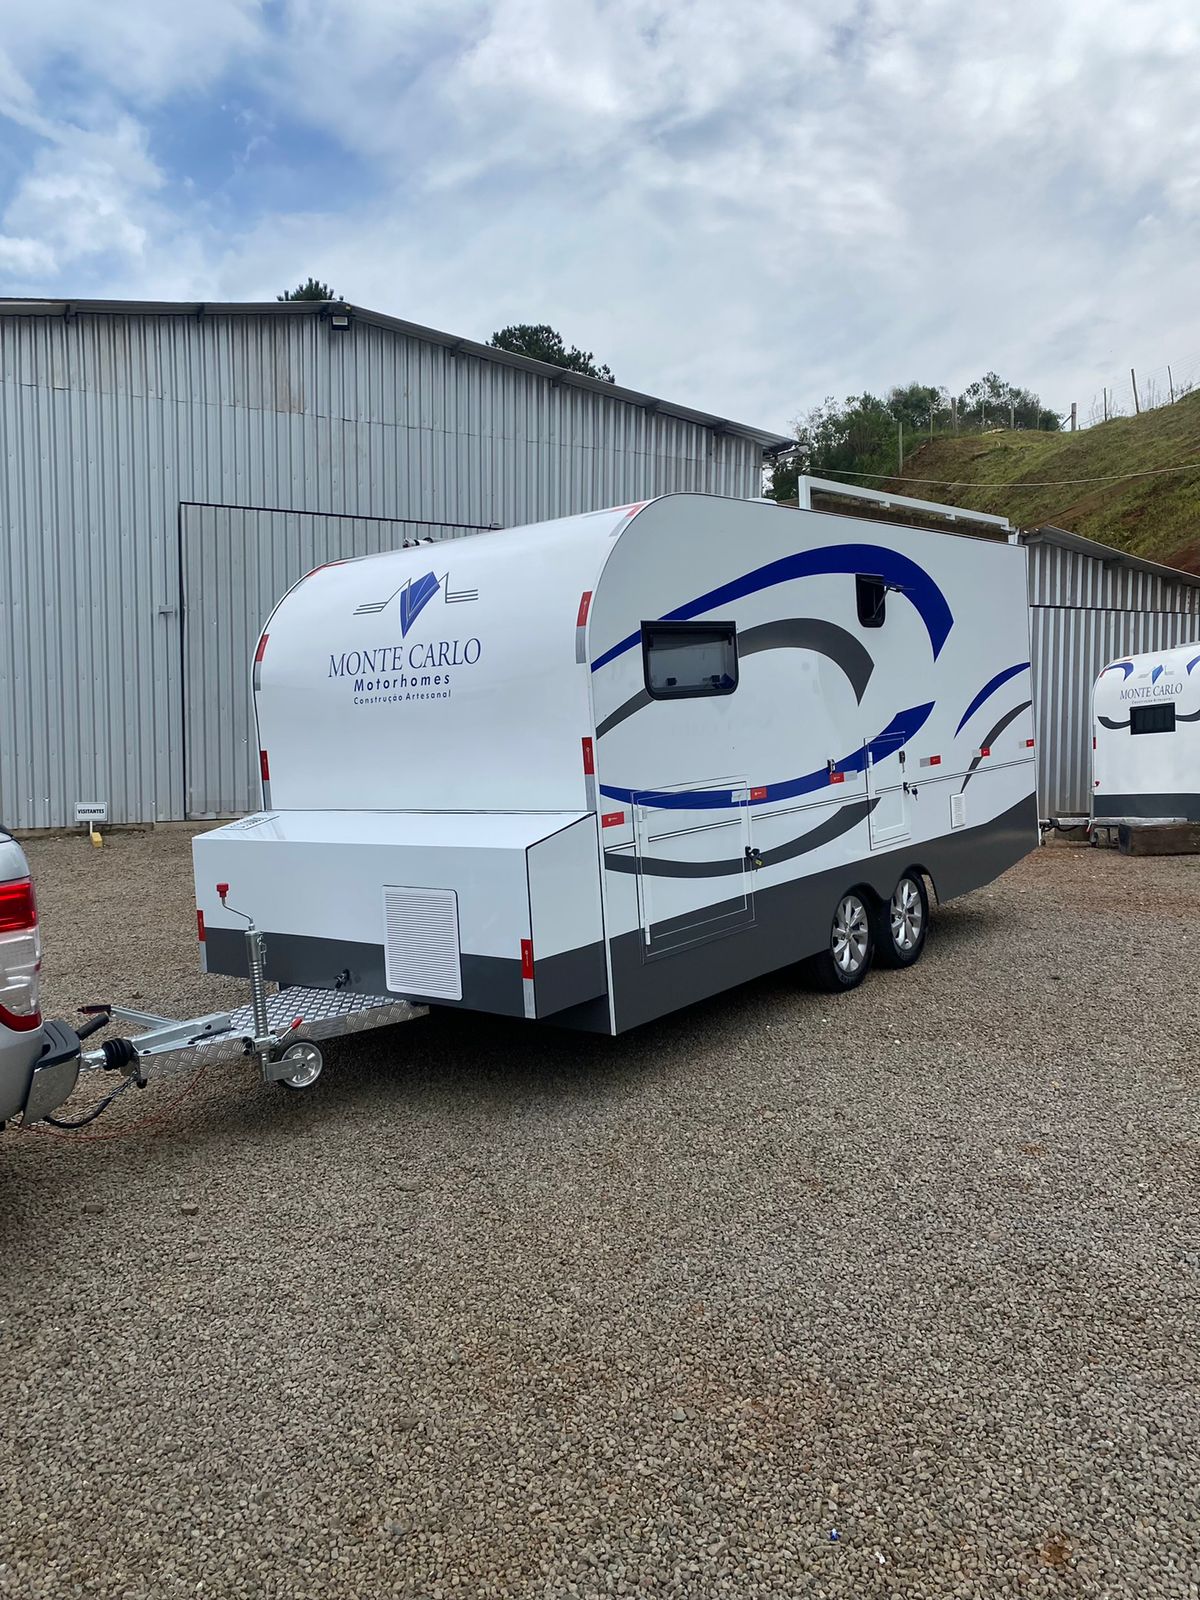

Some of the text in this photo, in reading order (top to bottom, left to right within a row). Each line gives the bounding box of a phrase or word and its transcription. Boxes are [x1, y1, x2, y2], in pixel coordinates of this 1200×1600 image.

[328, 637, 482, 678] MONTE CARLO
[353, 674, 450, 692] Motorhomes
[1119, 682, 1183, 700] MONTE CARLO
[353, 689, 452, 705] Construção Artesanal
